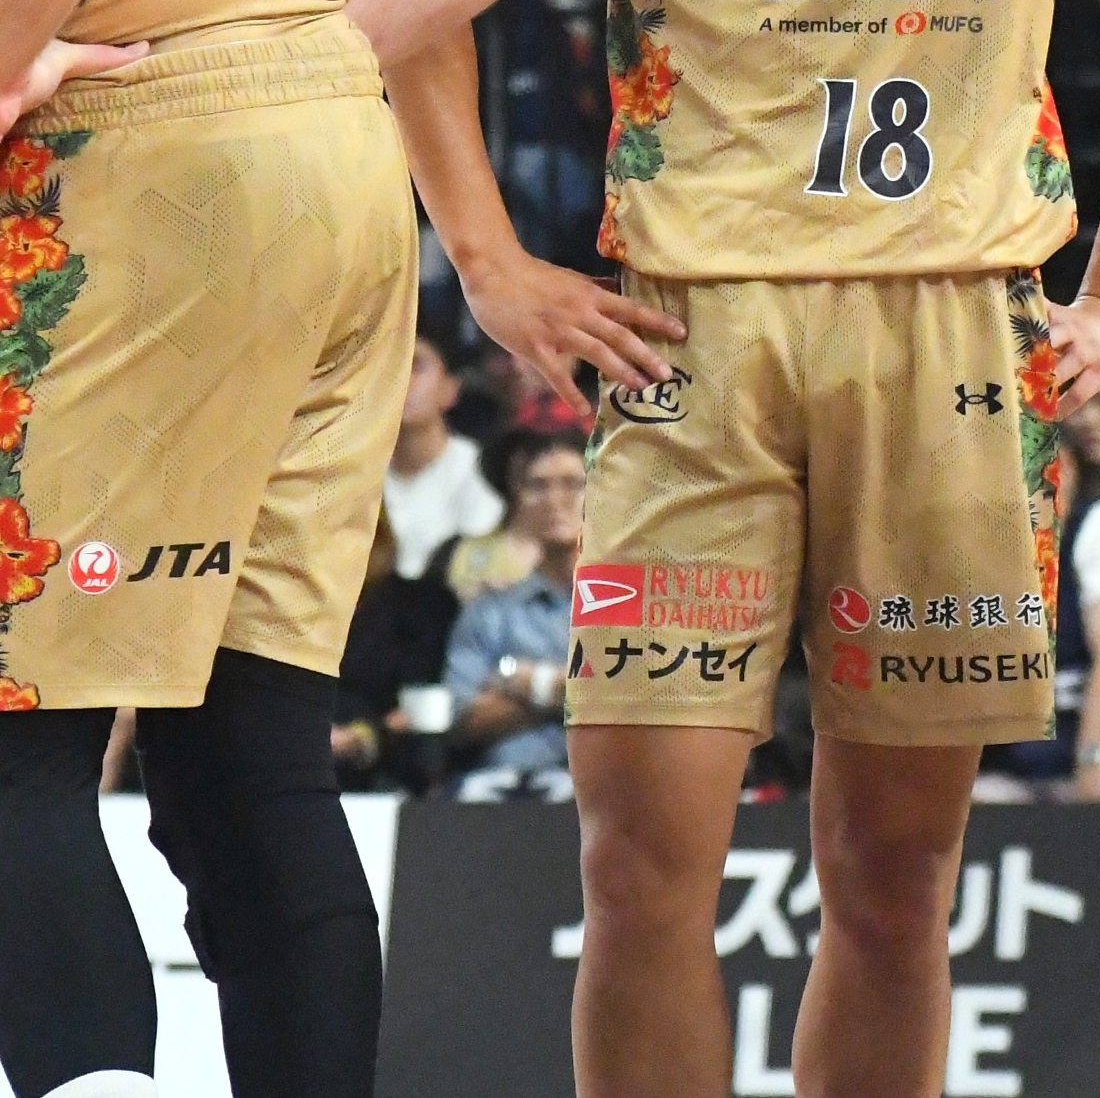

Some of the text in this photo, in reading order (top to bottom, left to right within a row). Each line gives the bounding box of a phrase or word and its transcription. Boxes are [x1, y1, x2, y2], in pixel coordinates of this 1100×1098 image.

[759, 15, 983, 34] A member of MUFG
[803, 77, 934, 202] 18
[81, 540, 231, 588] JAL JTA
[650, 565, 770, 601] RYUKYU
[878, 592, 1044, 632] 琉球銀行
[604, 638, 758, 682] ナンセイ
[879, 653, 1049, 684] RYUSEKI
